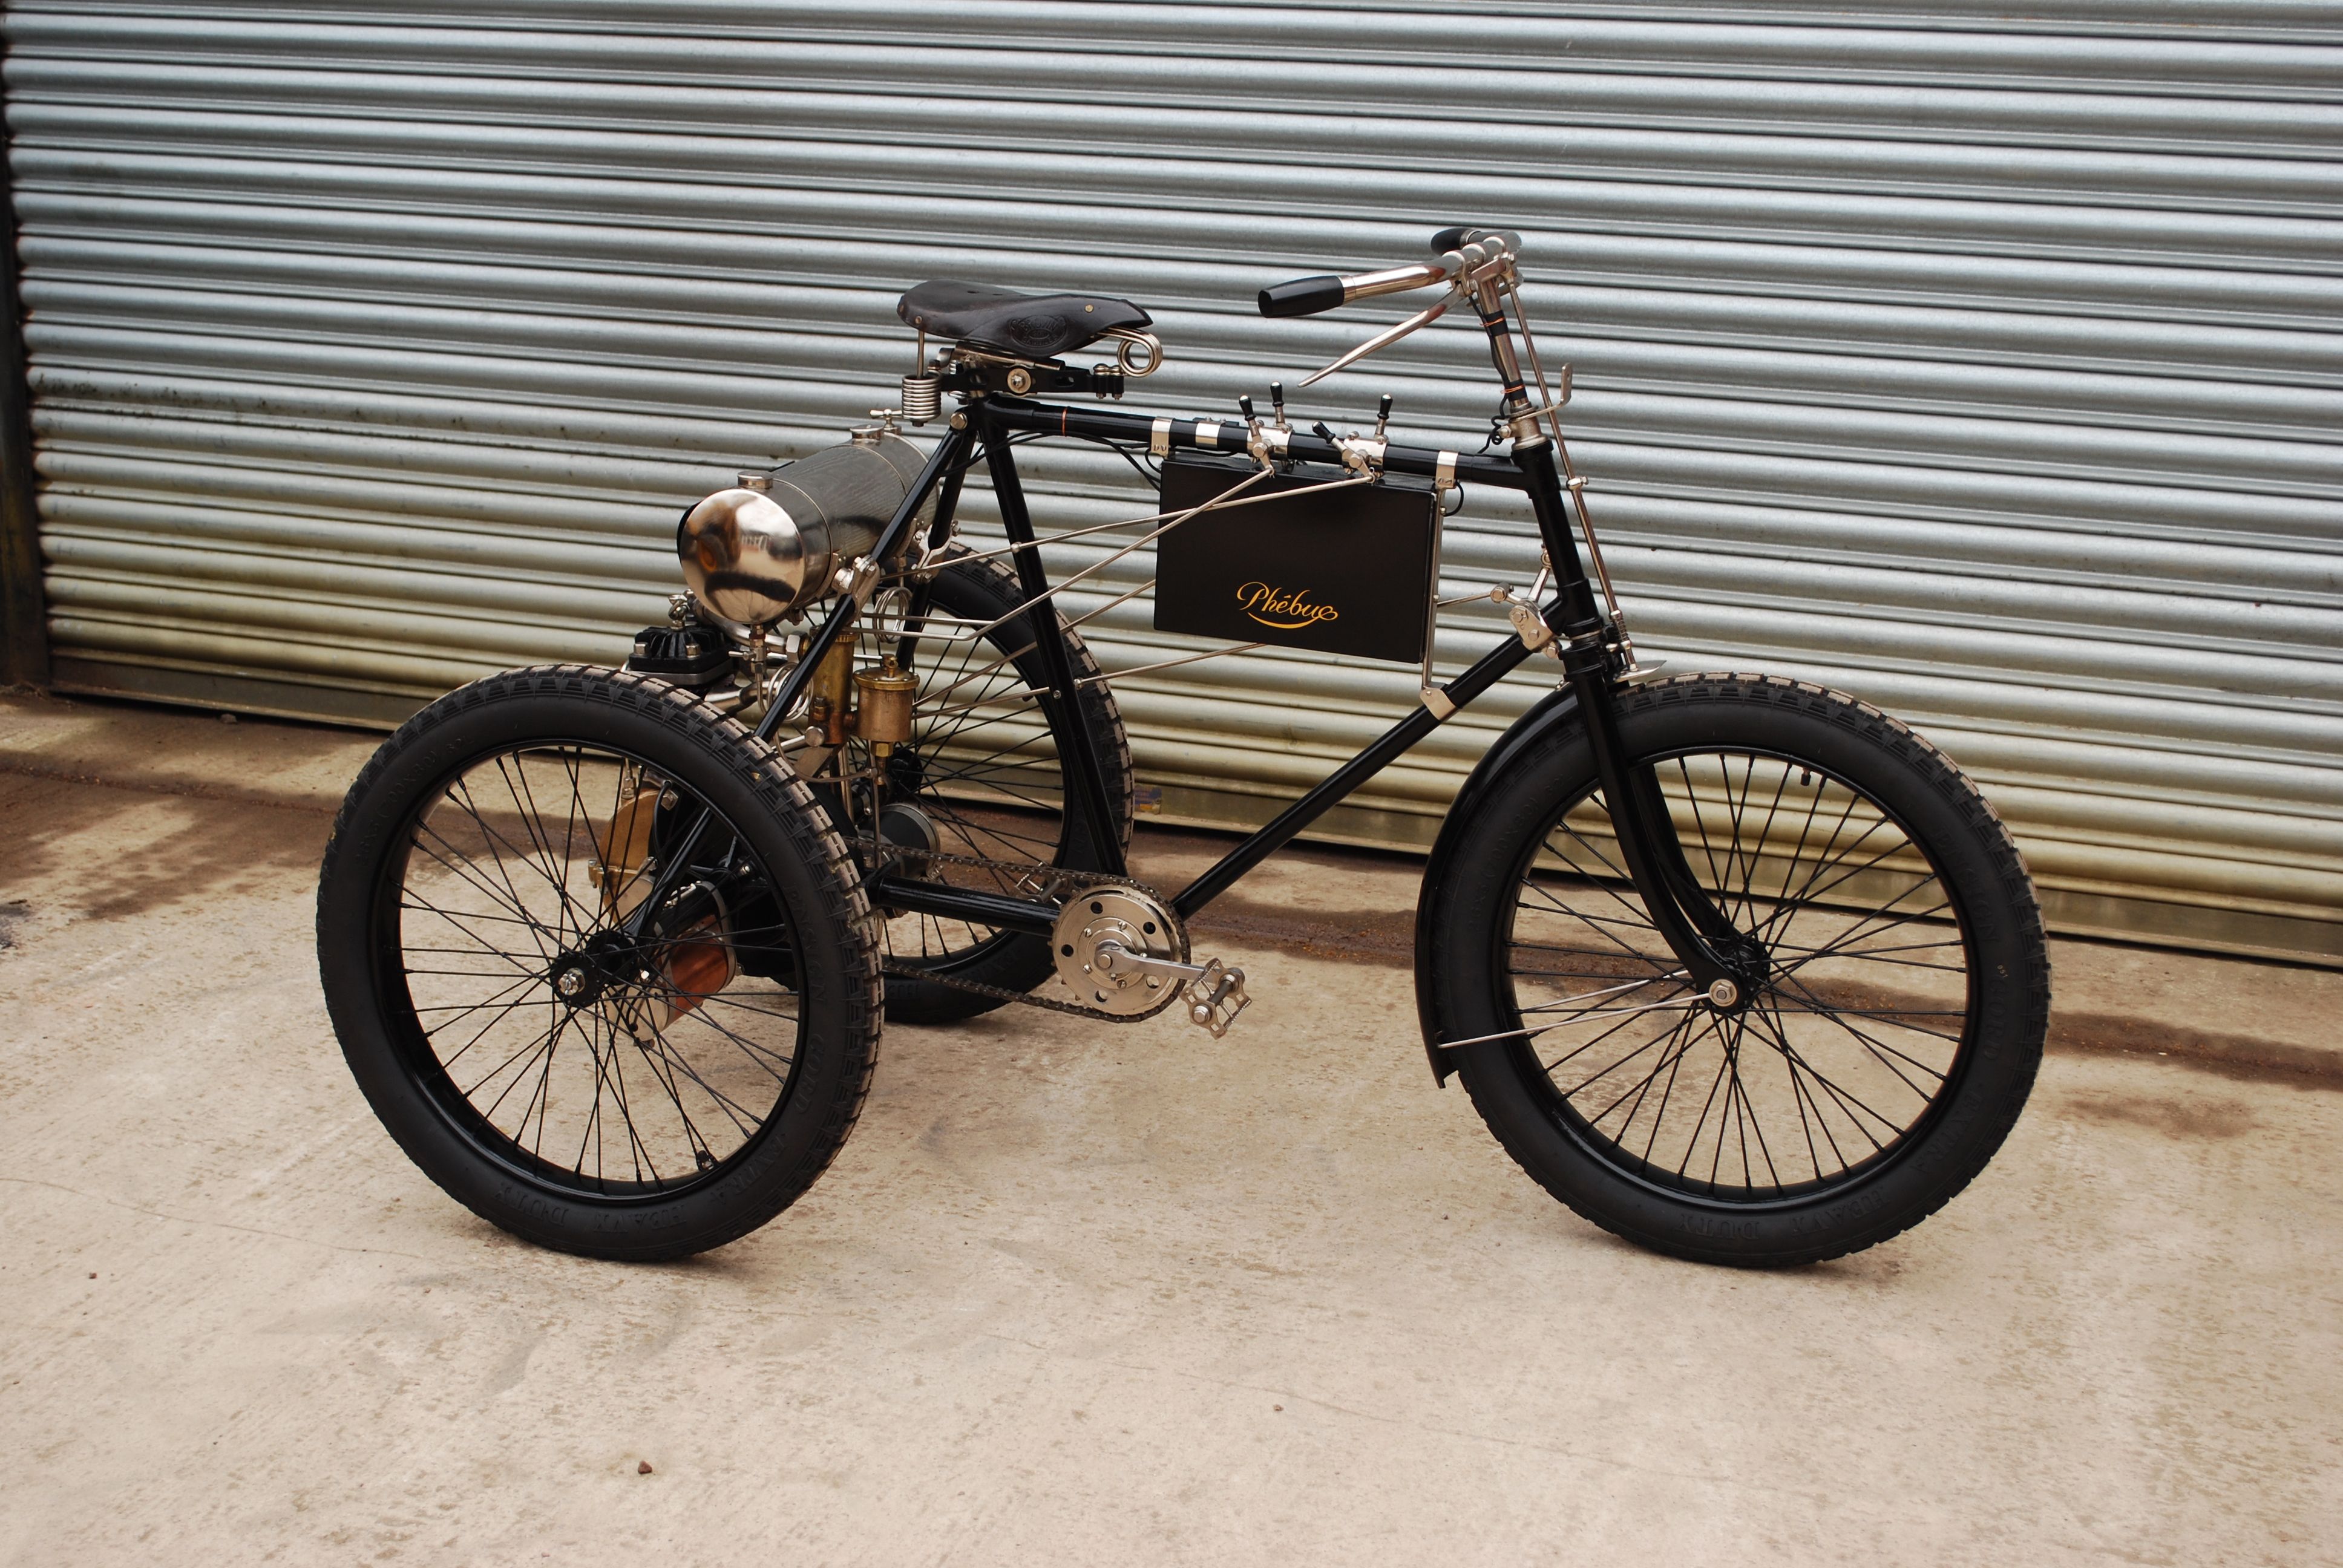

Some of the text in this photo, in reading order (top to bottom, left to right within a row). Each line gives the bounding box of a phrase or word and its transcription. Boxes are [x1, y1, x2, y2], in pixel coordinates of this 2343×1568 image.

[1236, 581, 1338, 629] Phébus
[1981, 975, 2010, 1060] CORD
[795, 1034, 825, 1114] CORD
[491, 1187, 569, 1227] DUTY
[593, 1204, 688, 1233] HEAVY
[1674, 1214, 1759, 1240] DUTY
[1791, 1189, 1890, 1237] HEAVY
